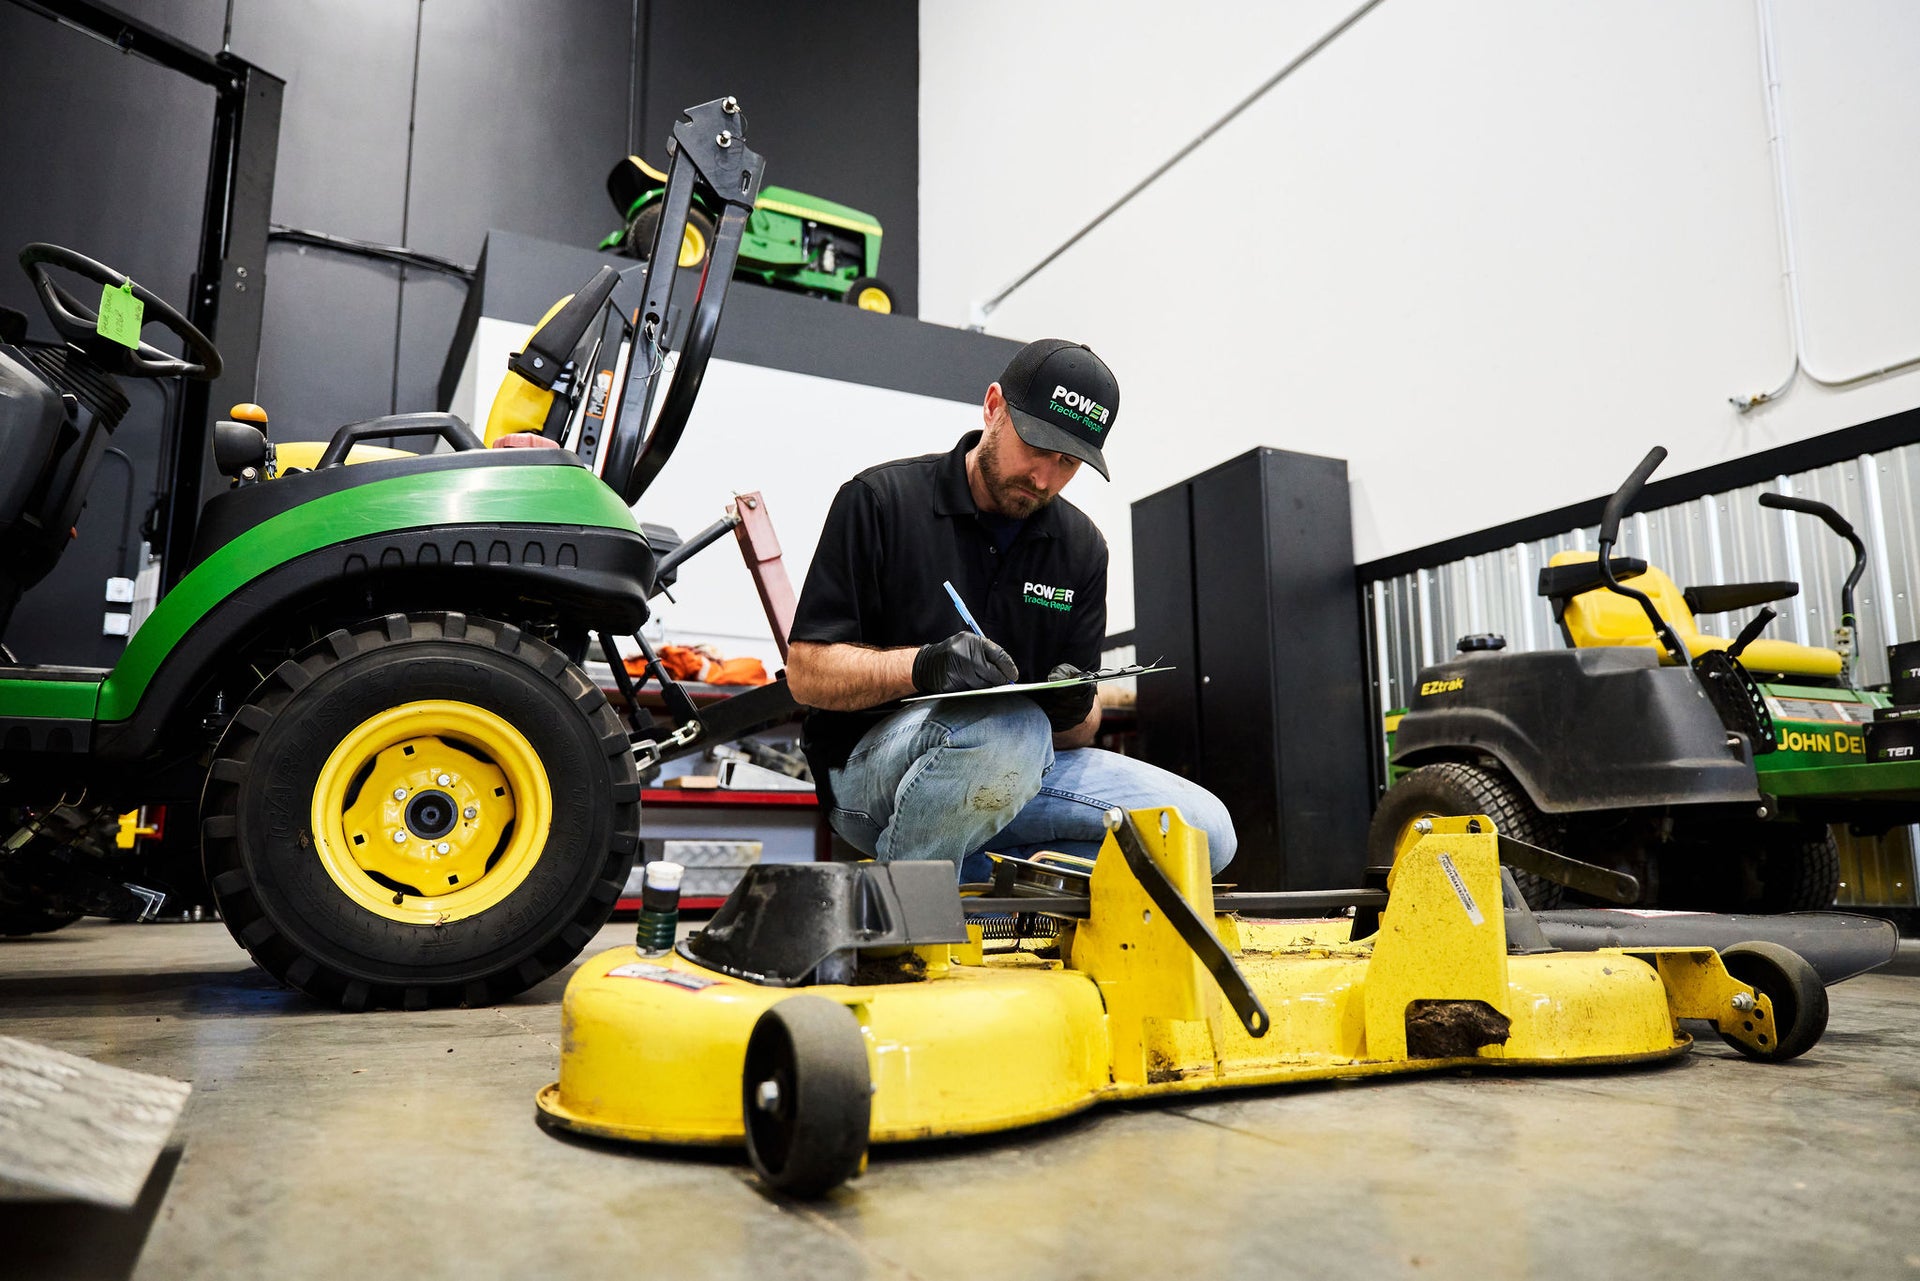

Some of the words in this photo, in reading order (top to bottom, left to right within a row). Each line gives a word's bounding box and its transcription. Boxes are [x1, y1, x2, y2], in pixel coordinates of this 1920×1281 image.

[1049, 400, 1082, 421] Tractor
[1082, 416, 1103, 433] Repair
[1051, 385, 1110, 425] POWER
[1023, 582, 1074, 603] POWER
[1023, 594, 1049, 607] Tractor
[1050, 600, 1073, 612] Repair
[1421, 677, 1464, 697] EZtrak
[1777, 728, 1831, 753] JOHN
[1834, 731, 1866, 754] DE
